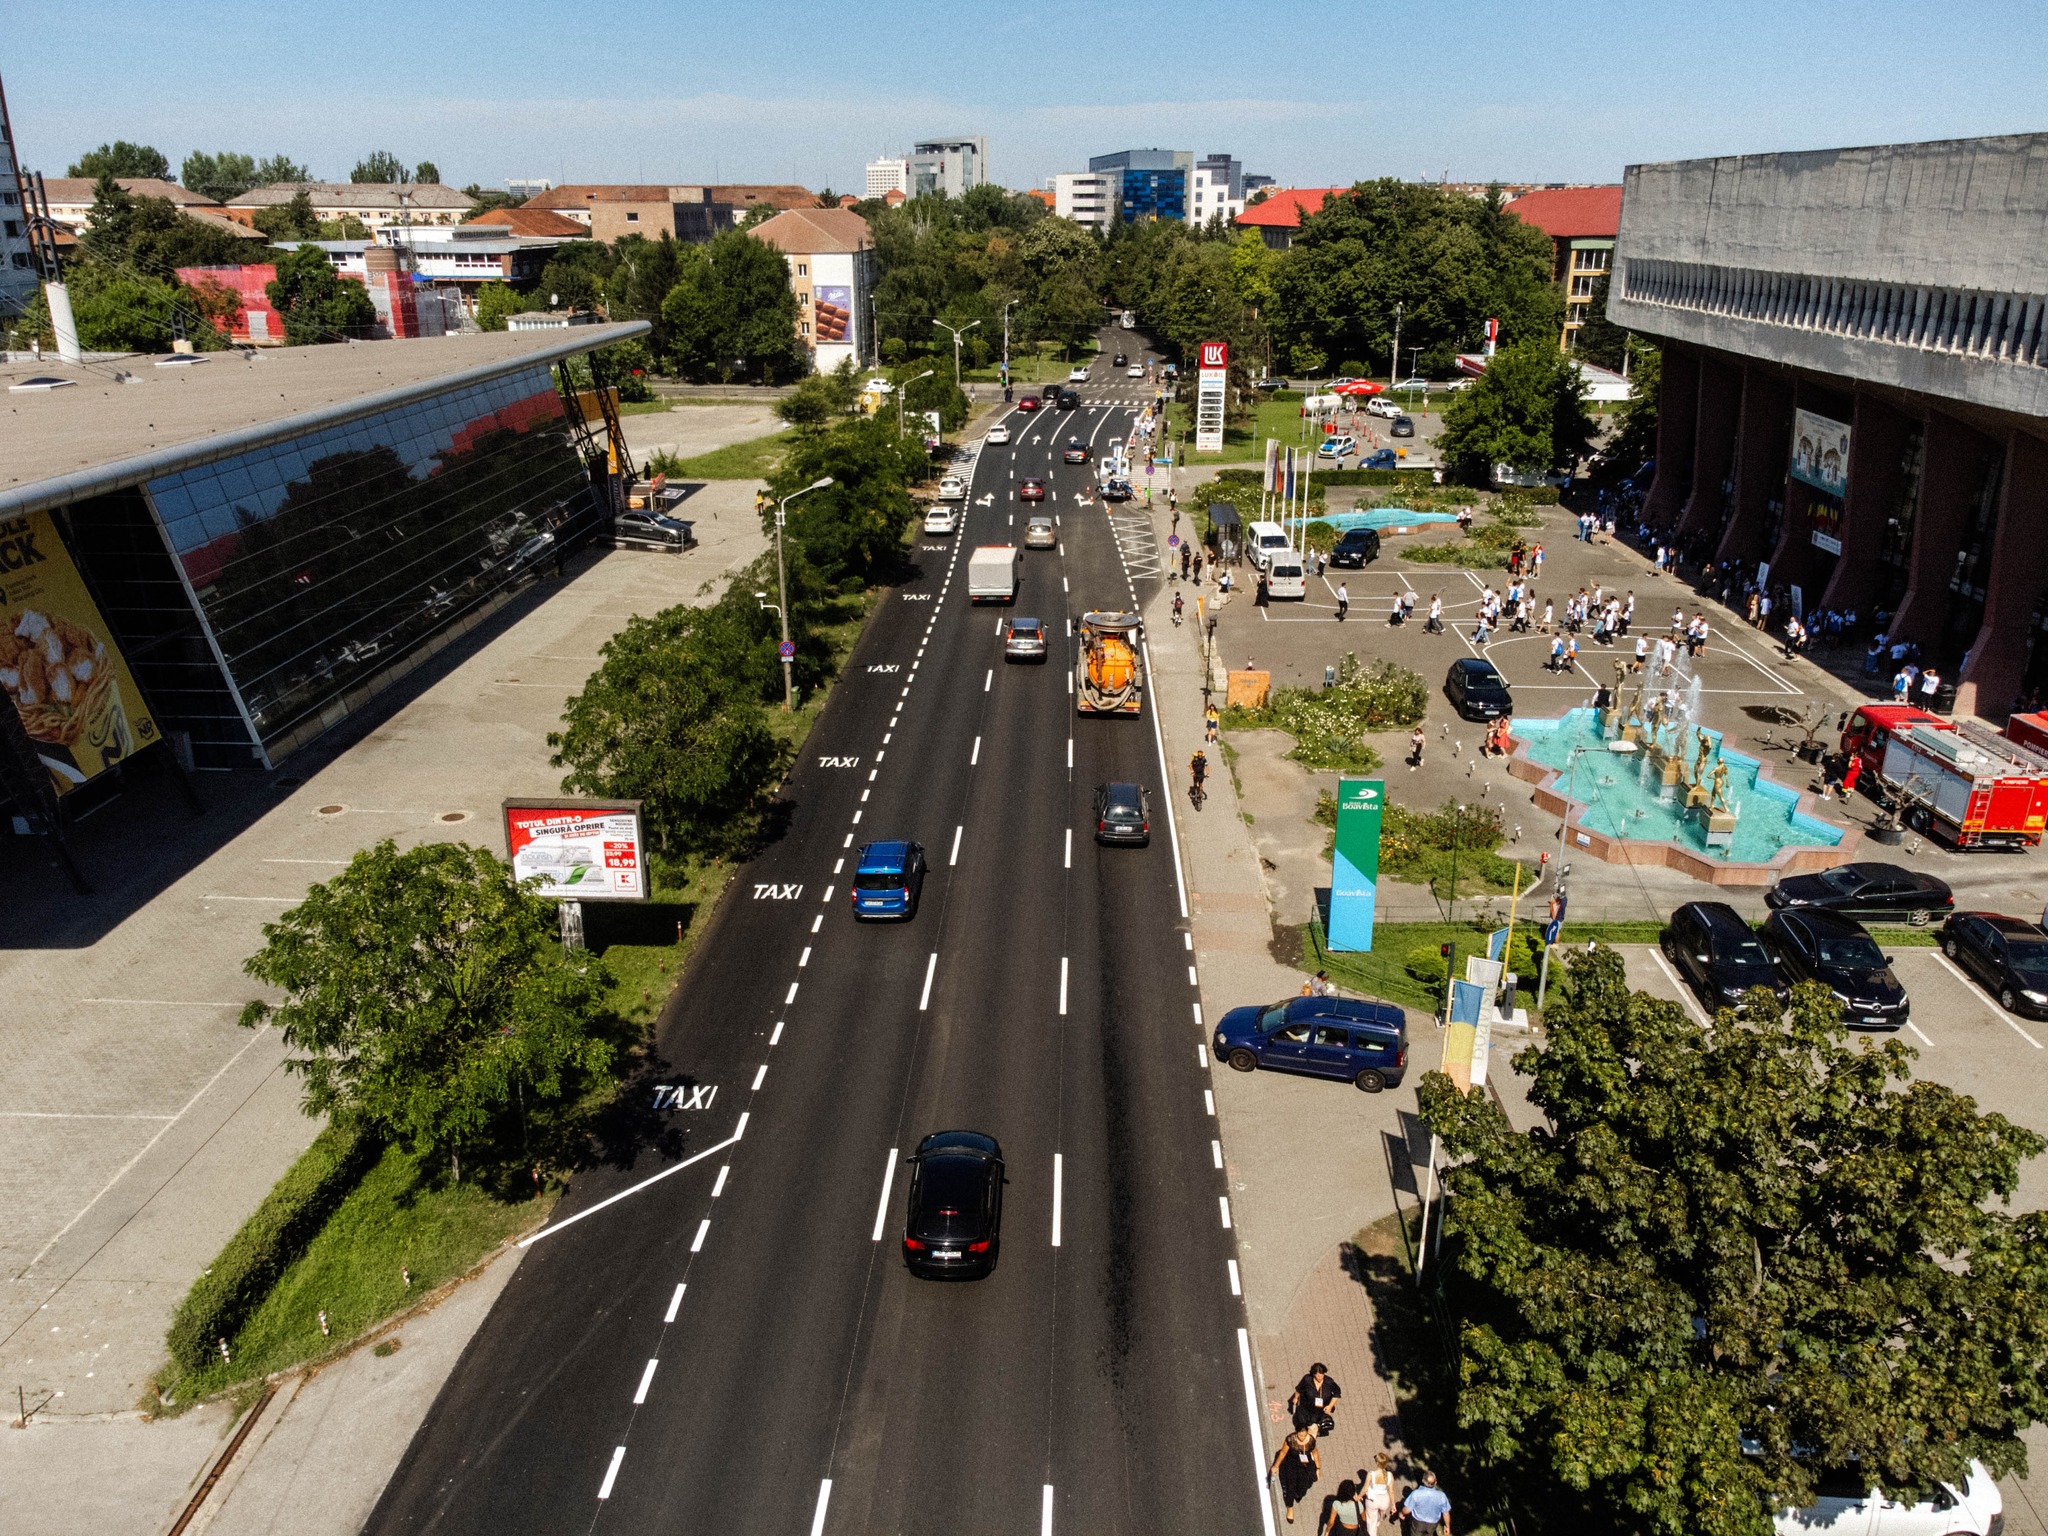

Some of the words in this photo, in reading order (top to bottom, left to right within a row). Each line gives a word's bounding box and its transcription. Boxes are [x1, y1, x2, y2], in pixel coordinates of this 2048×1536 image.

[867, 664, 900, 673] TAXI
[818, 756, 860, 768] TAXI
[516, 819, 545, 829] TOTUL
[546, 815, 582, 826] DINTR-O
[535, 825, 573, 836] SINGURĂ
[574, 822, 605, 832] OPRIRE
[608, 858, 635, 868] 18,99
[753, 884, 804, 900] TAXI
[652, 1085, 719, 1110] TAXI
